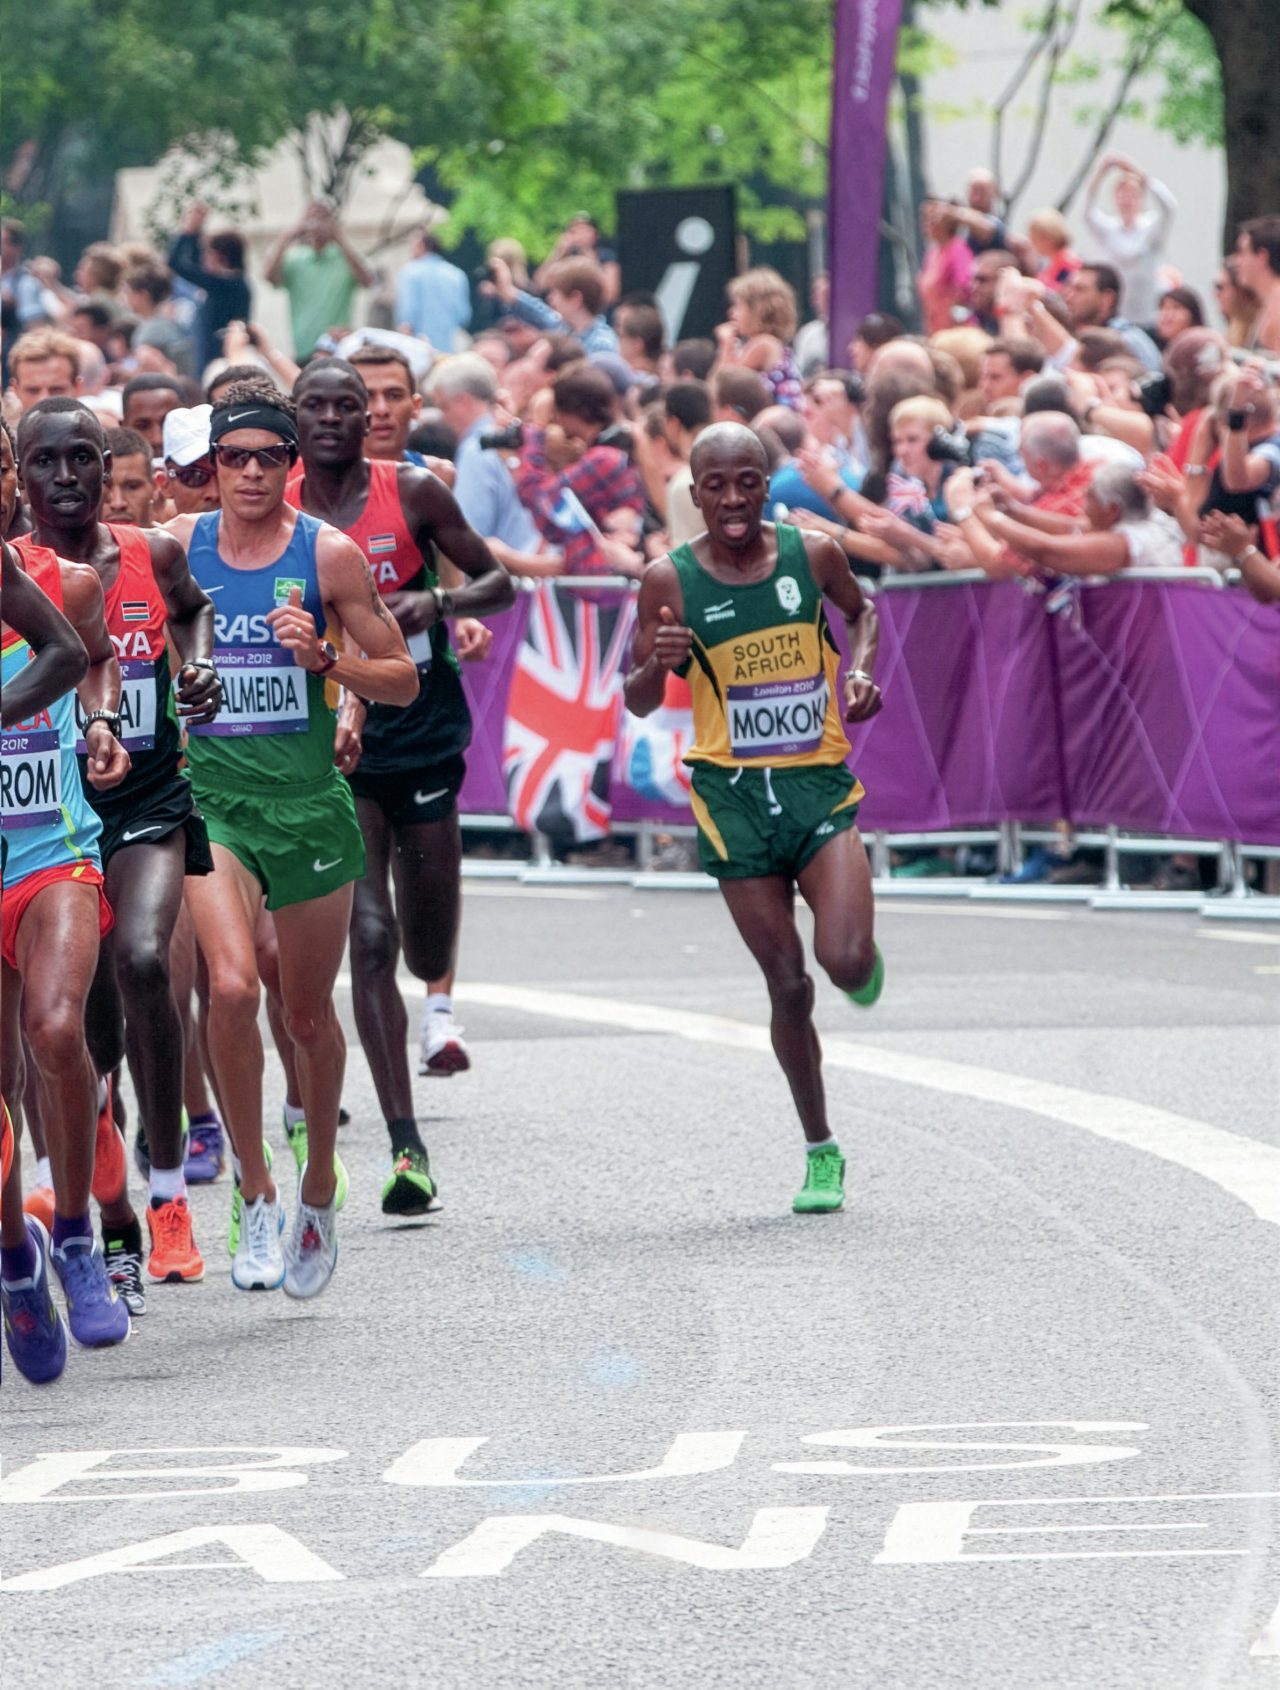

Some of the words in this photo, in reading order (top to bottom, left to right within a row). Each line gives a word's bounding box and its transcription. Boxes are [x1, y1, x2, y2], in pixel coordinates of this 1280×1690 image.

[734, 632, 800, 662] SOUTH
[734, 650, 806, 681] AFRICA
[219, 674, 300, 714] ALMEIDA
